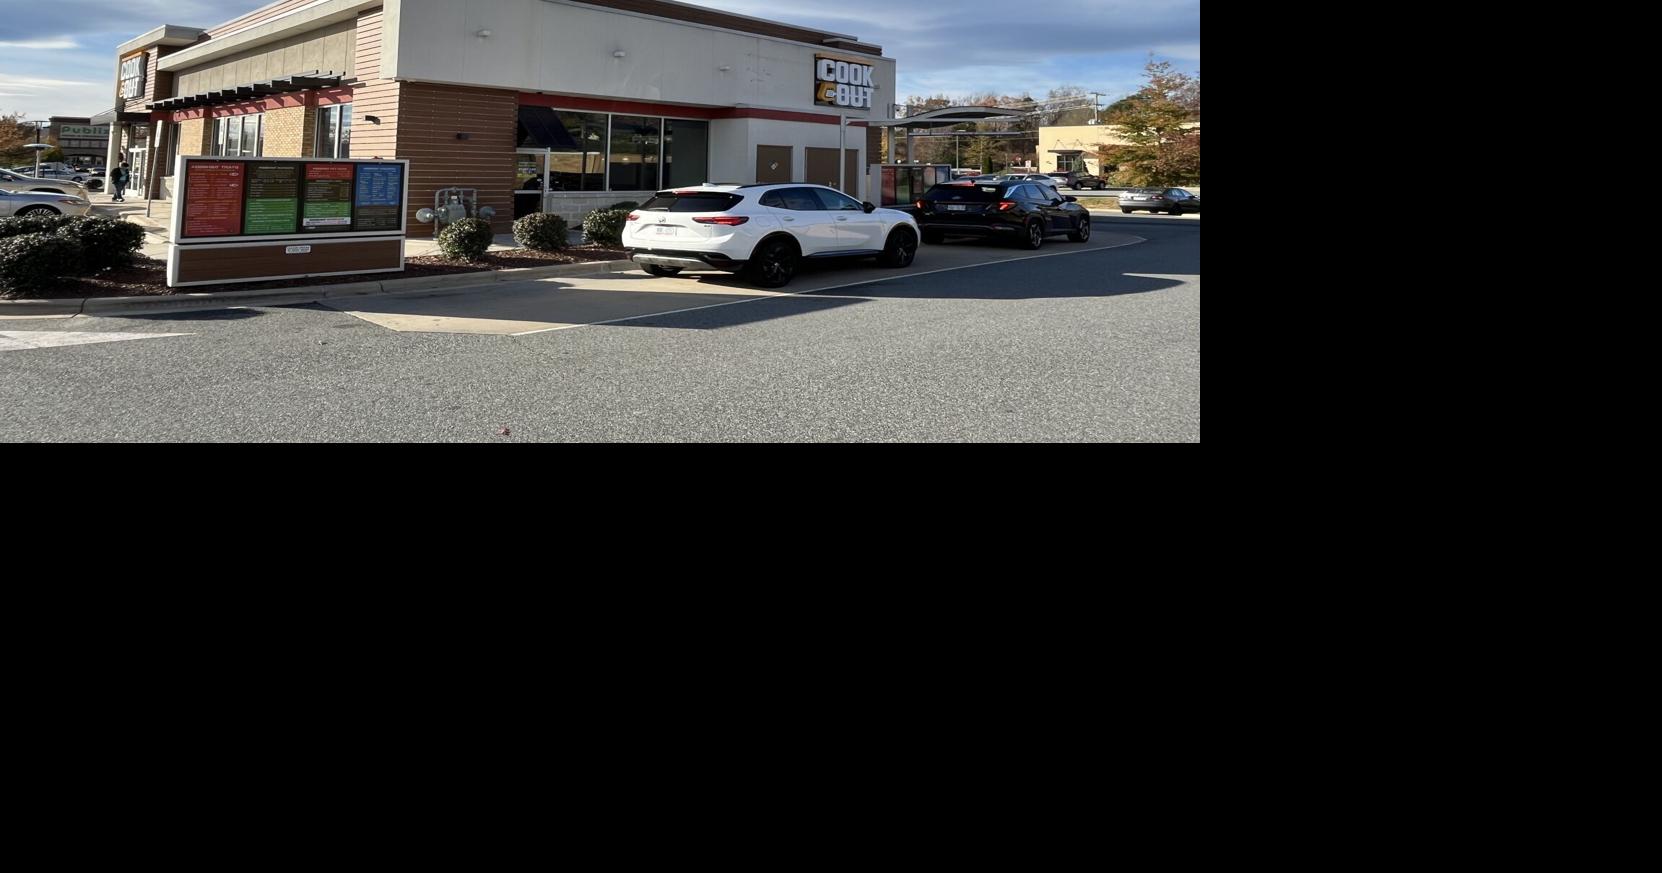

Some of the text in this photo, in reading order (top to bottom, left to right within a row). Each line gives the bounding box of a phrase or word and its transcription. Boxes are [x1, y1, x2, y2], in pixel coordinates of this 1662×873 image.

[121, 56, 140, 80] COOK
[817, 59, 874, 87] COOK
[123, 77, 139, 99] OUT
[836, 84, 874, 107] OUT
